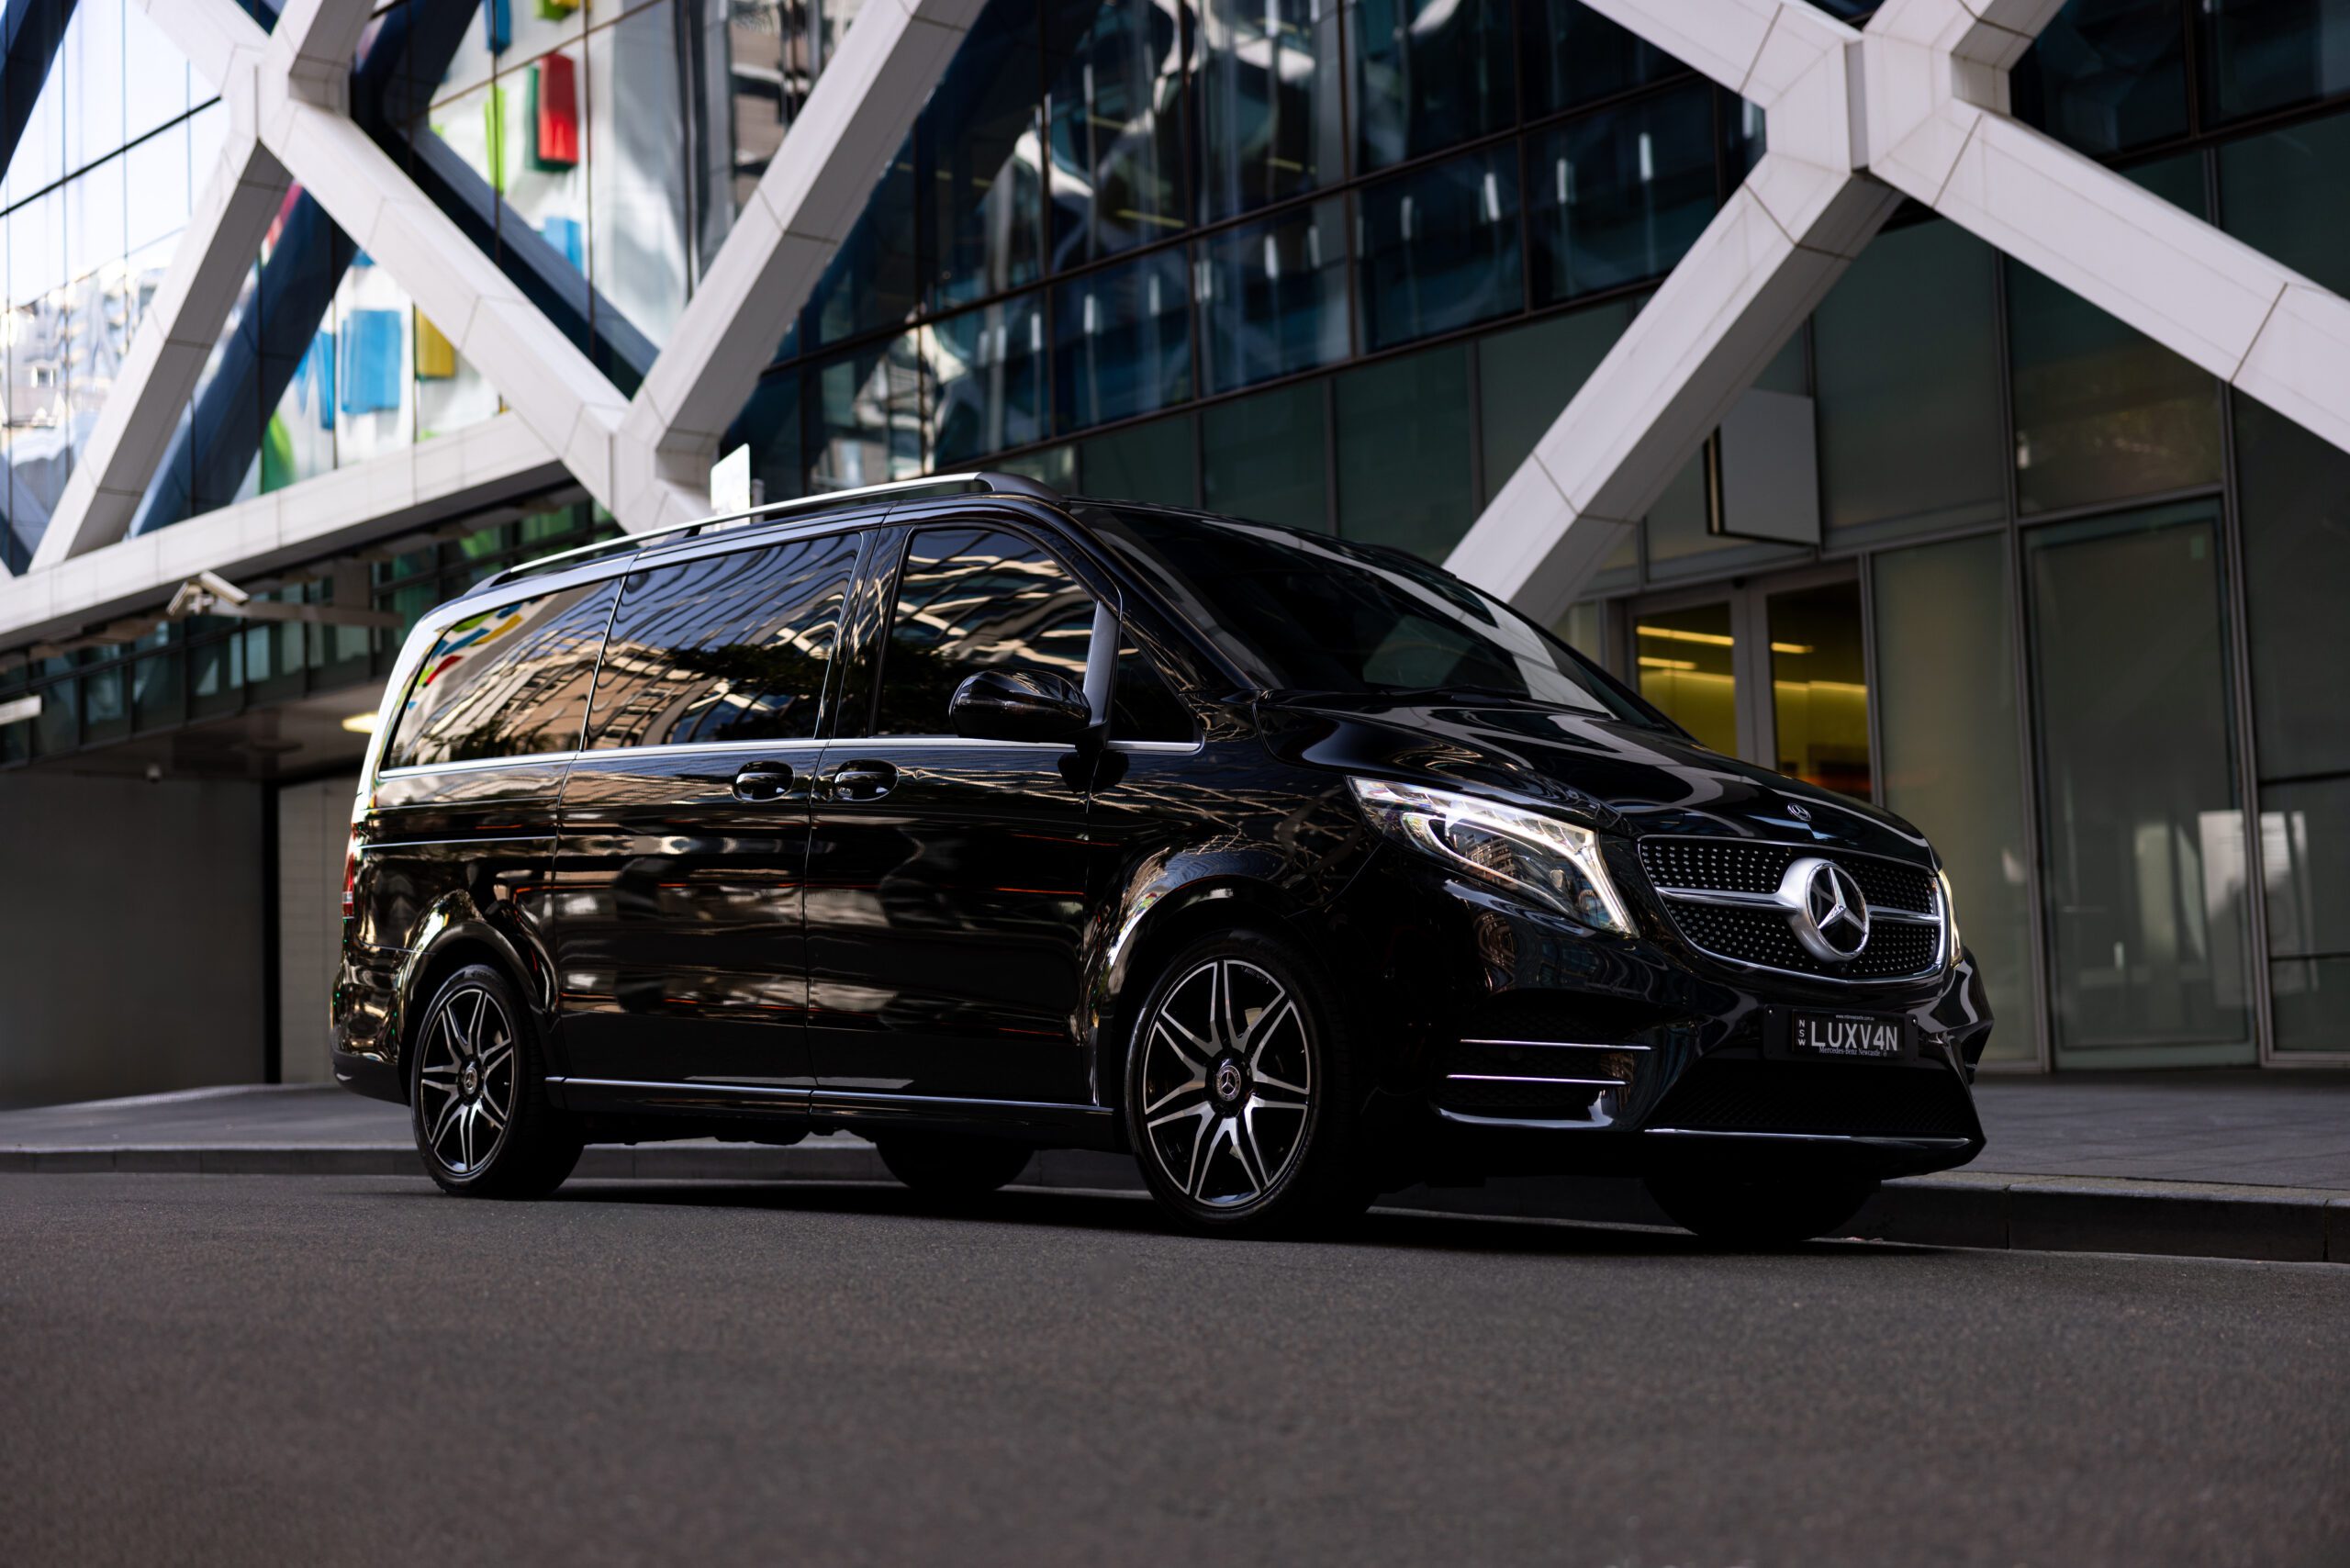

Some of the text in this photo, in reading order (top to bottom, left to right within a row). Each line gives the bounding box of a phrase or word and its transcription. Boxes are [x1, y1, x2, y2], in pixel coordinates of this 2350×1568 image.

[1797, 1019, 1807, 1047] NSW
[1811, 1021, 1897, 1051] LUXV4N
[1818, 1046, 1857, 1055] Mercedes-Benz
